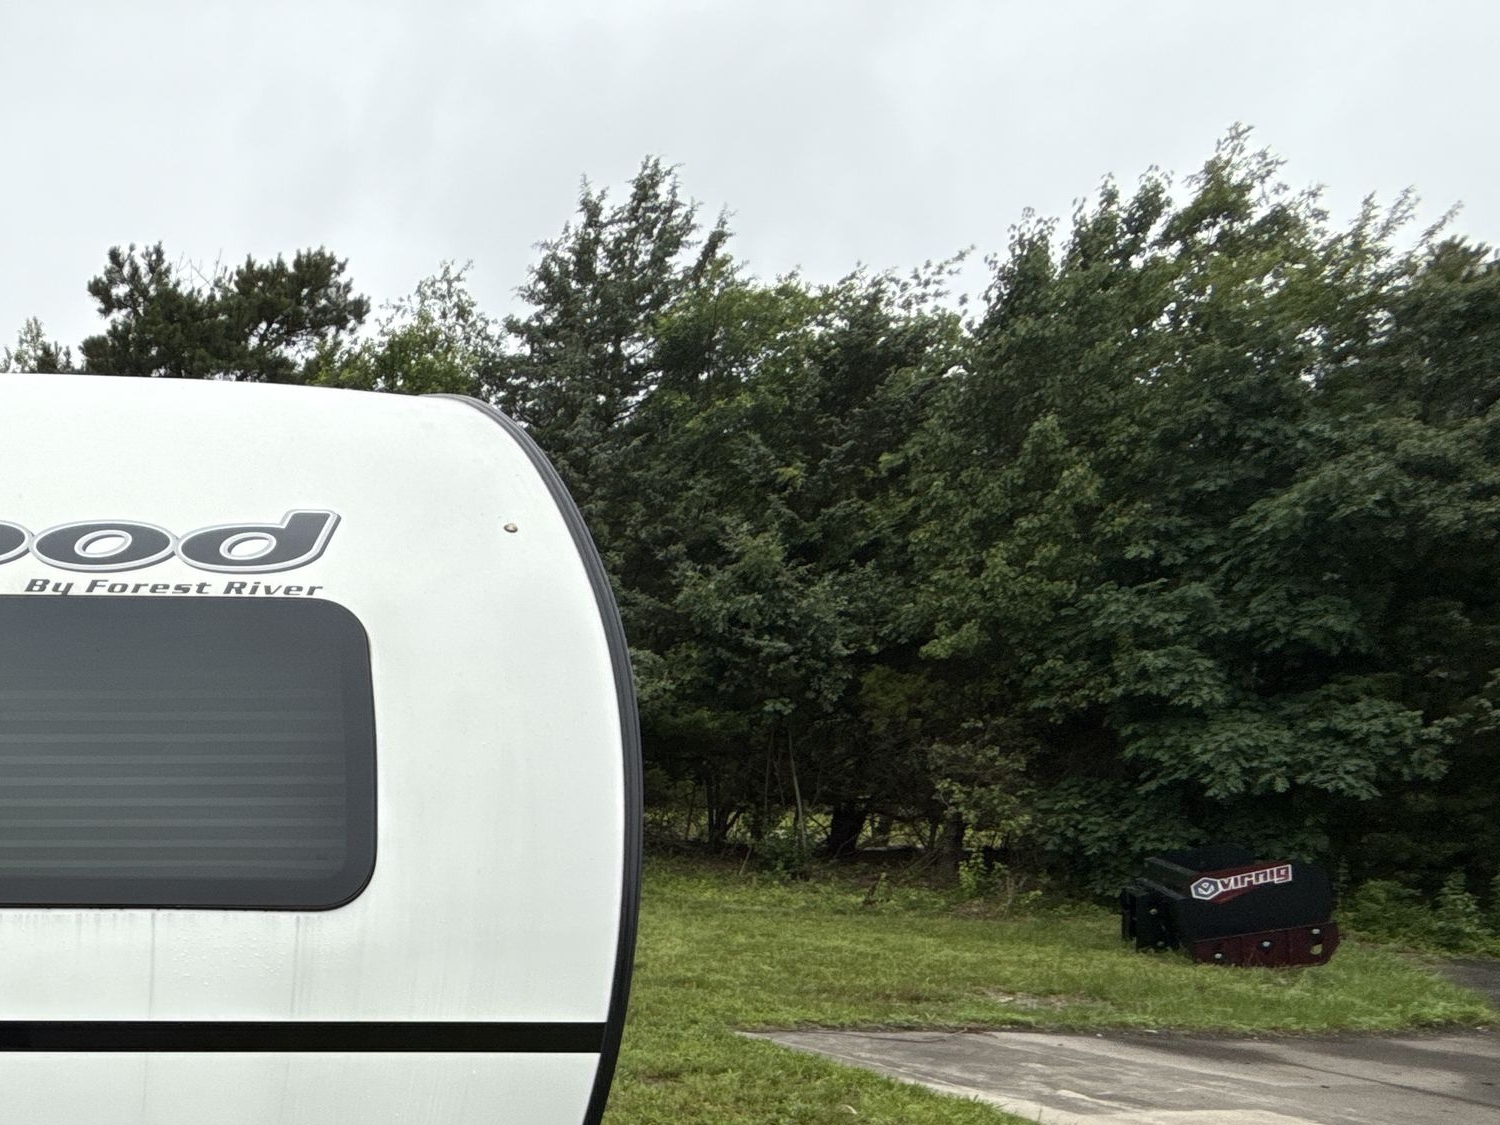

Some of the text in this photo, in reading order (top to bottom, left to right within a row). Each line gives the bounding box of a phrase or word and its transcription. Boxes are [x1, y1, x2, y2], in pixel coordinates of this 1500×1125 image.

[25, 578, 324, 596] By Forest River
